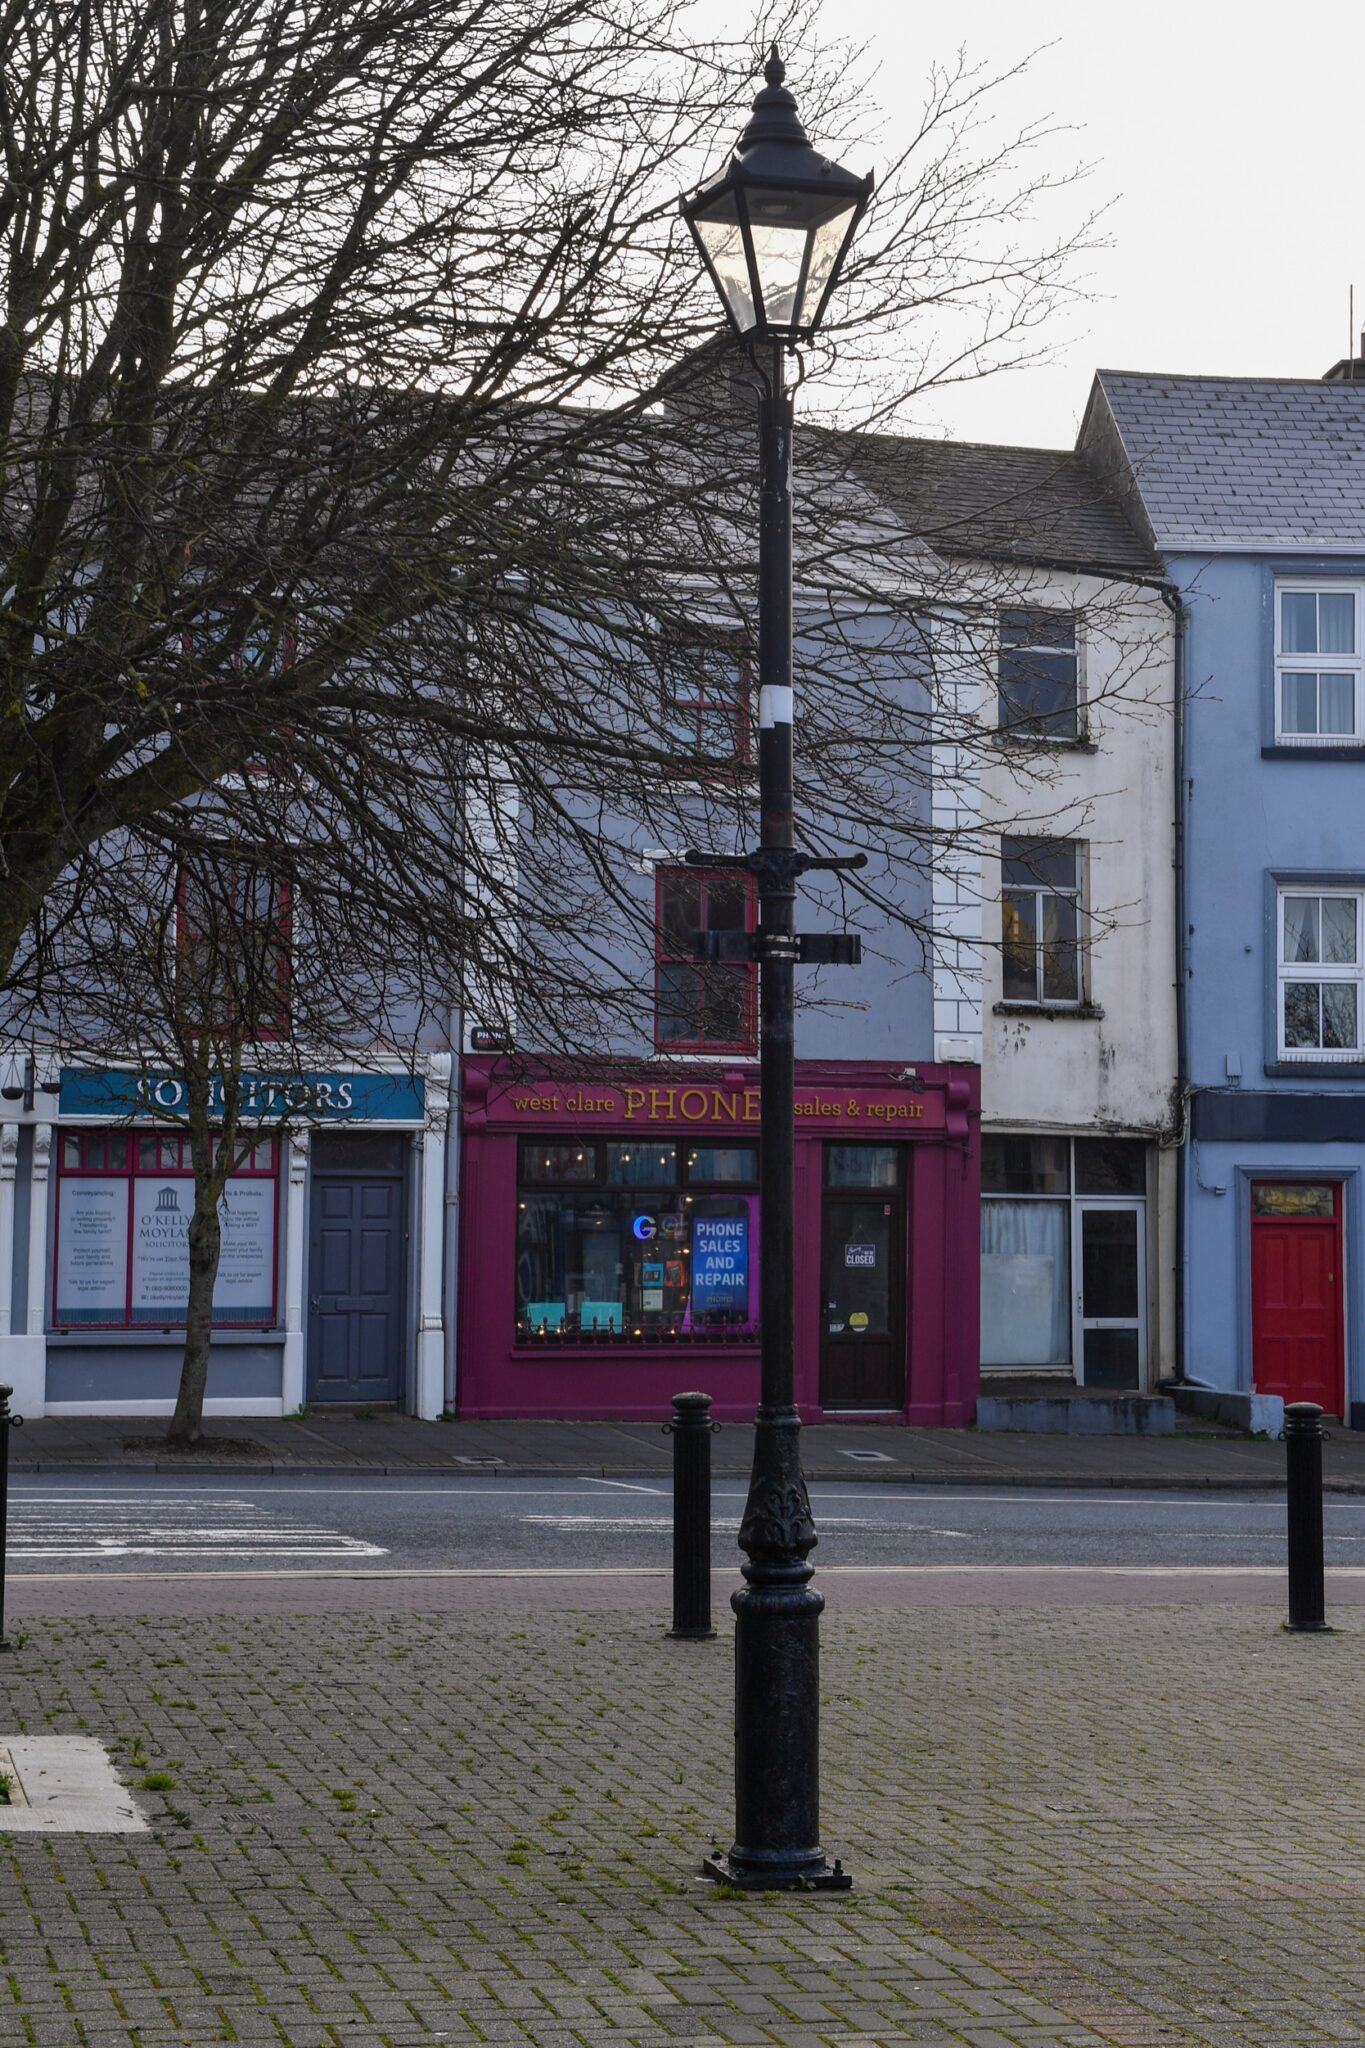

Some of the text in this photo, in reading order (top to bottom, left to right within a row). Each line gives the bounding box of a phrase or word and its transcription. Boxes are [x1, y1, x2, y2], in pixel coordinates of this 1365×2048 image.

[136, 1079, 353, 1109] SOIITORS
[513, 1096, 559, 1112] west
[567, 1090, 616, 1112] clare
[793, 1096, 842, 1116] sales
[847, 1099, 862, 1116] &
[867, 1100, 924, 1122] repair
[141, 1215, 193, 1226] O'KELLY
[697, 1223, 745, 1237] PHONE
[699, 1239, 742, 1254] SALES
[705, 1256, 736, 1270] AND
[846, 1254, 874, 1265] CLOSED
[695, 1272, 746, 1287] REPAIR
